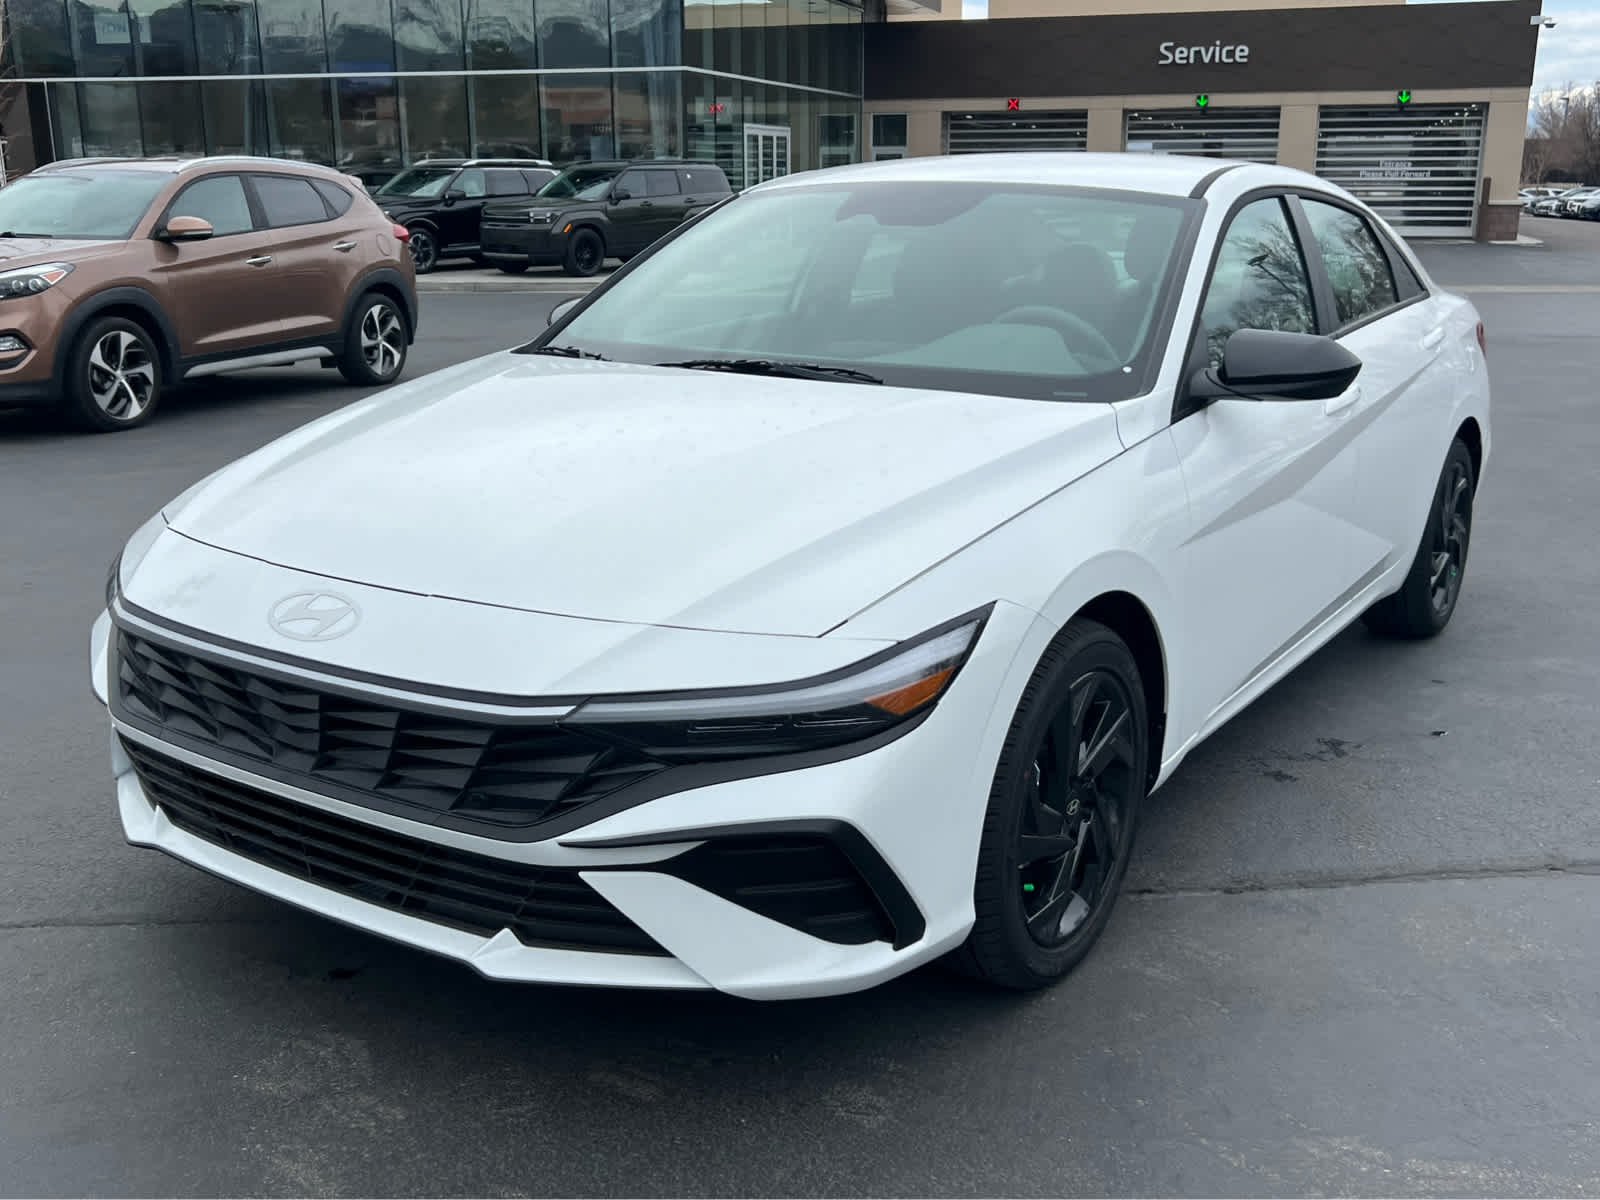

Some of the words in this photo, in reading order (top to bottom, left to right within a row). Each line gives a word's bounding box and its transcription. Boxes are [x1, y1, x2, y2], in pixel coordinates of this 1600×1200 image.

[1158, 40, 1249, 65] Service
[1379, 160, 1413, 169] Entrance
[1359, 168, 1383, 178] Please
[1384, 168, 1400, 178] Pull
[1401, 168, 1431, 178] Forward
